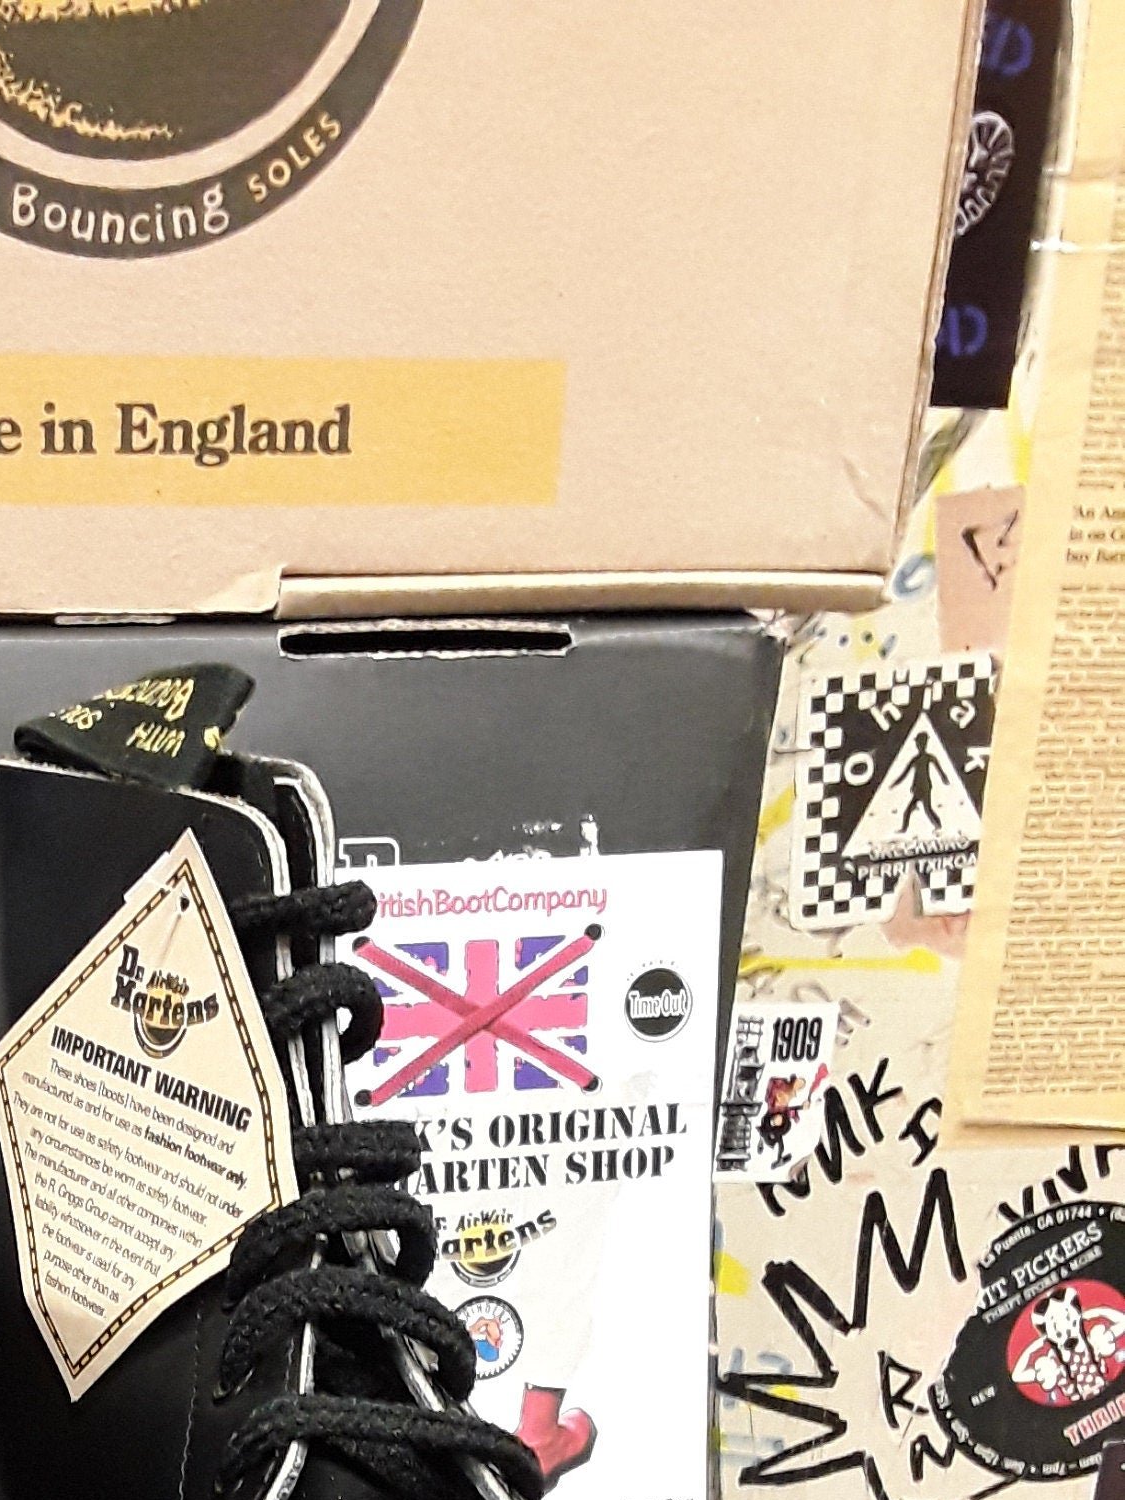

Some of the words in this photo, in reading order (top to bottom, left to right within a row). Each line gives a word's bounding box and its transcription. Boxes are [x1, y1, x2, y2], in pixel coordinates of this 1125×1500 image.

[11, 182, 230, 245] Bouncing
[247, 111, 344, 203] SOLES
[40, 401, 97, 456] in
[114, 403, 353, 467] England
[110, 974, 220, 1028] Martens
[771, 1017, 823, 1062] 1909
[51, 1025, 152, 1088] IMPORTANT
[154, 1070, 252, 1132] WARNING
[13, 1091, 30, 1115] They
[71, 1126, 85, 1139] use
[488, 1103, 688, 1149] ORIGINAL
[25, 1141, 39, 1162] The
[115, 1116, 130, 1131] use
[144, 1125, 182, 1155] fashion
[184, 1144, 226, 1176] footwear
[225, 1168, 247, 1191] only.
[412, 1152, 550, 1197] ARTEN
[565, 1144, 676, 1185] SHOP
[437, 1208, 557, 1261] artens
[1010, 1220, 1103, 1289] PICKERS
